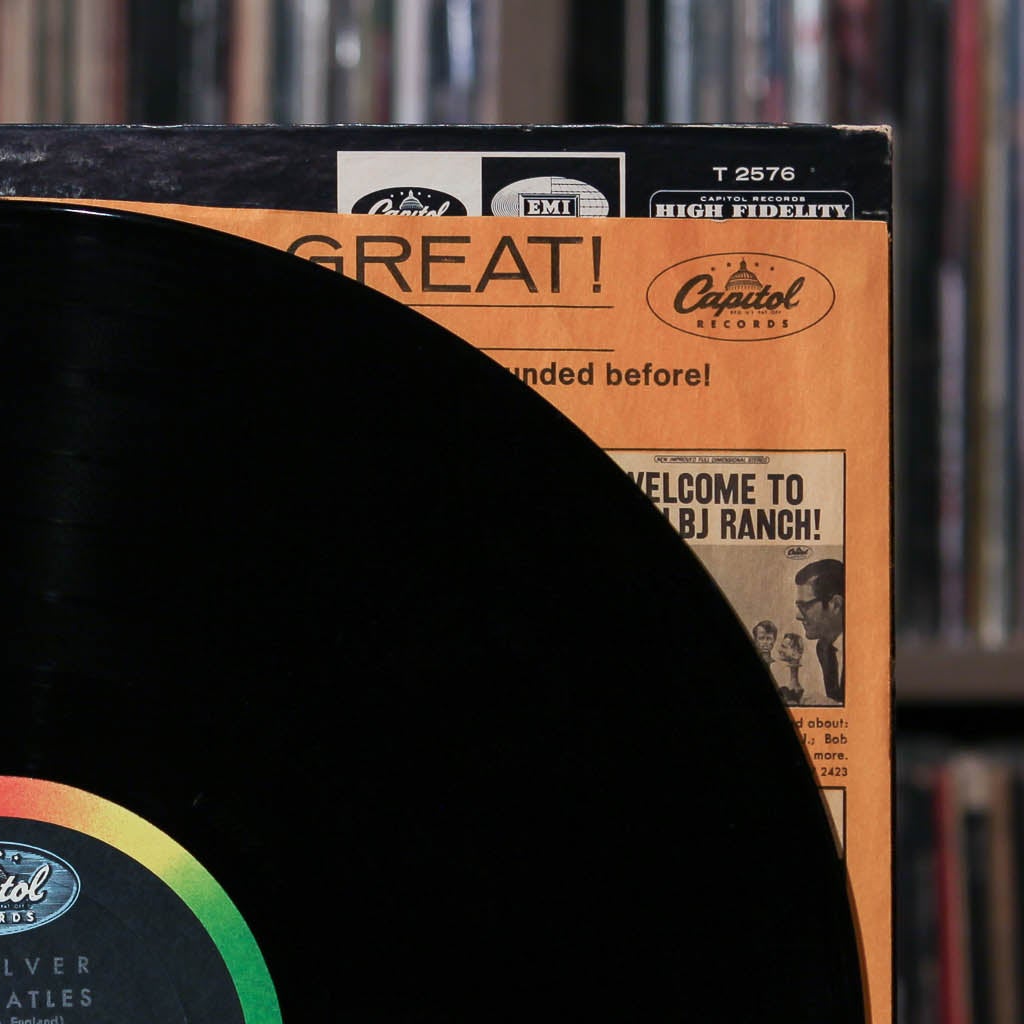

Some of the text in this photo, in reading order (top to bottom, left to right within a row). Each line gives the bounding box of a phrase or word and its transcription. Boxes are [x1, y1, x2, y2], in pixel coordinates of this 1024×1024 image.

[713, 167, 795, 181] T 2576
[527, 200, 571, 215] EMI
[655, 204, 849, 218] HIGH FIDELITY
[287, 234, 602, 293] GREAT!
[674, 274, 805, 316] Capitol
[697, 320, 789, 328] RECORDS
[606, 363, 711, 386] before!
[768, 474, 804, 505] TO
[721, 509, 821, 540] RANCH!
[808, 718, 849, 729] about:
[825, 734, 848, 745] Bob
[814, 752, 849, 761] more.
[821, 767, 848, 777] 2423
